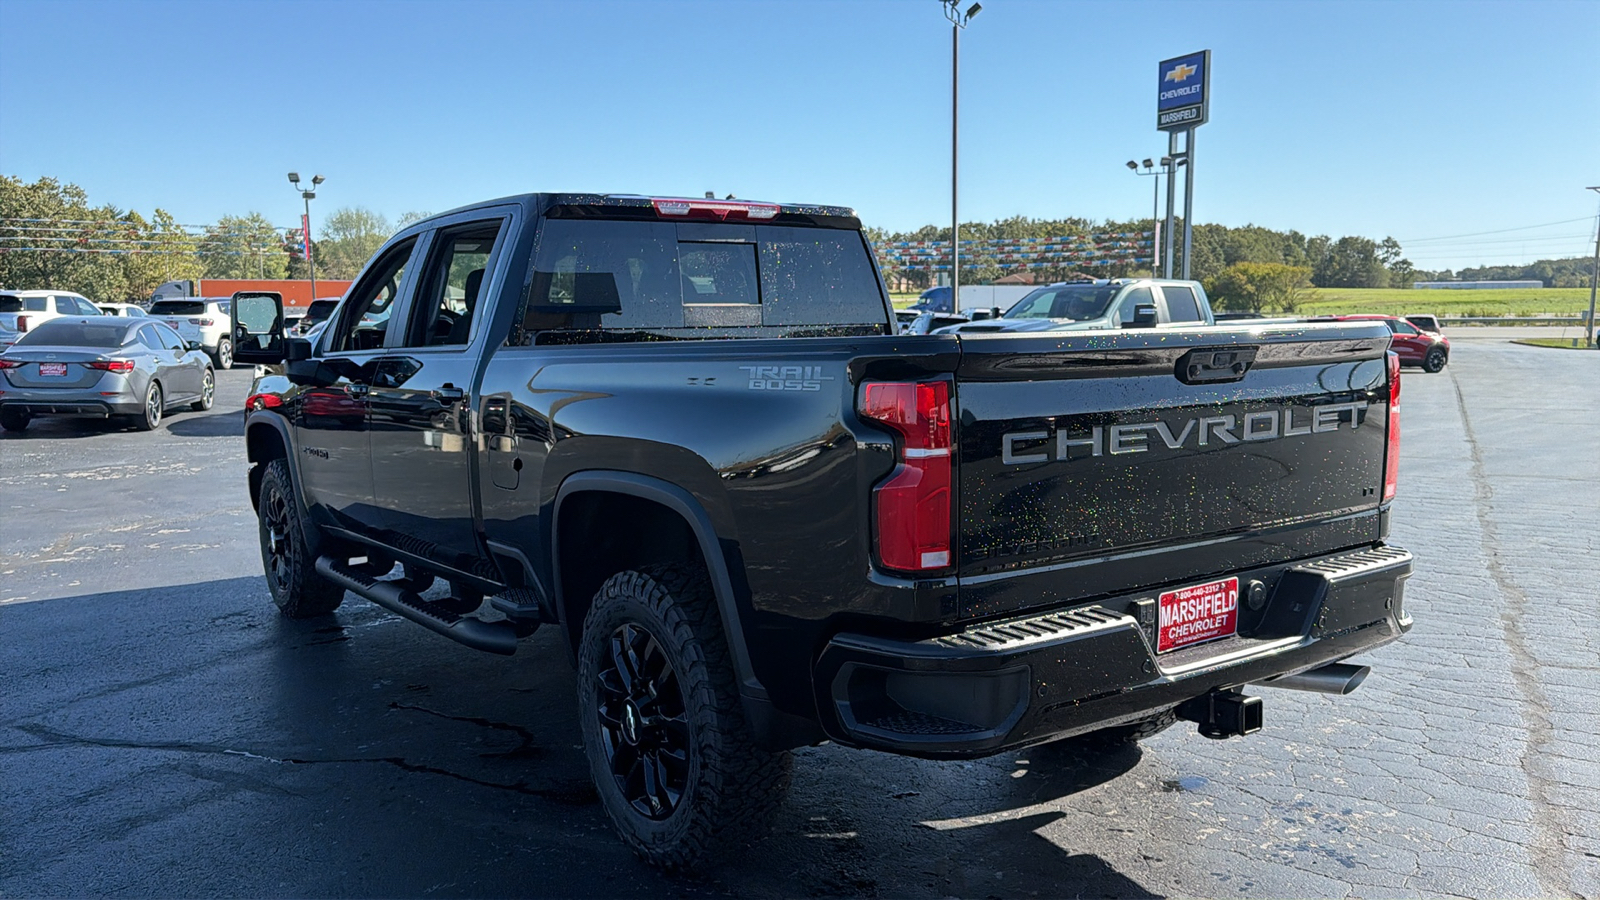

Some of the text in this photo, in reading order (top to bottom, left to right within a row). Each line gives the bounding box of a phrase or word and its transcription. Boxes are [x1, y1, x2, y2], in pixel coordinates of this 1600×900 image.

[1160, 84, 1201, 100] CHEVROLET
[1161, 108, 1197, 124] MARSHFIELD
[739, 366, 834, 381] TRAIL
[748, 380, 821, 391] BOSS
[1002, 401, 1369, 466] CHEVROLET
[1161, 590, 1237, 628] MARSHFIELD
[1168, 614, 1229, 639] CHEVROLET
